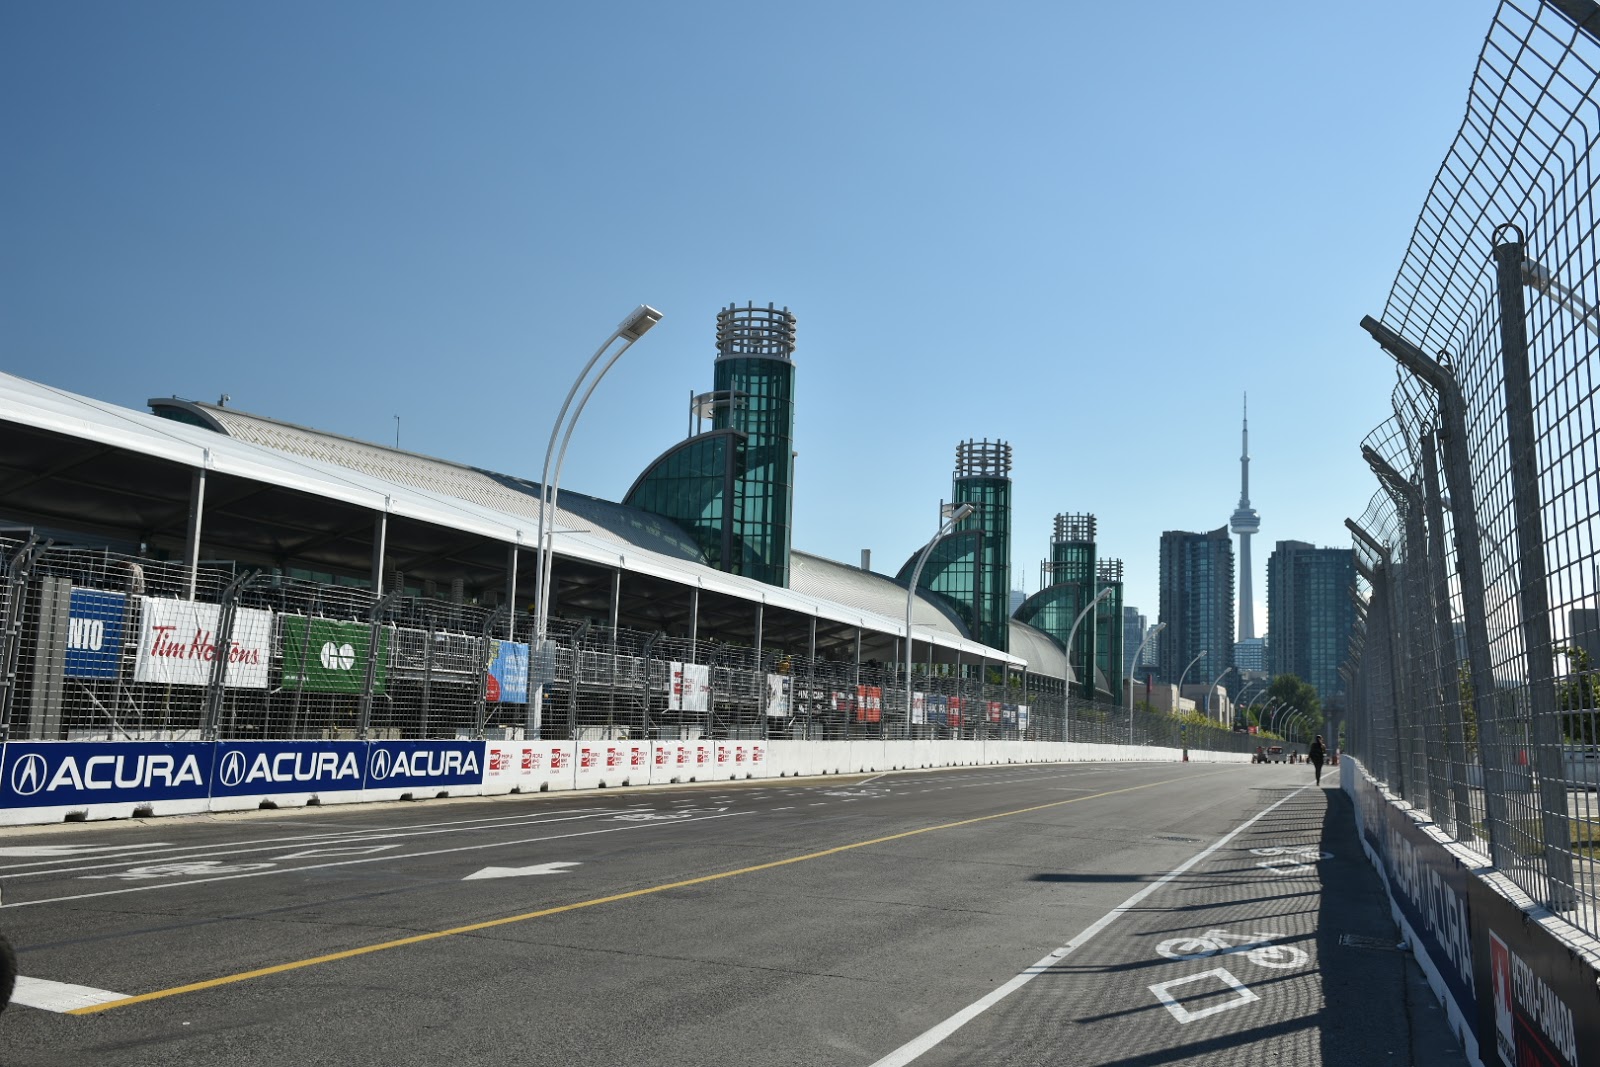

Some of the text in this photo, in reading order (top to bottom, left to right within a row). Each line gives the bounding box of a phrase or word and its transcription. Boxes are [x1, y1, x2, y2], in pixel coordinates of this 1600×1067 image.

[151, 626, 258, 664] Tim Hoons
[46, 754, 203, 791] ACURA
[245, 752, 360, 783] ACURA
[390, 750, 479, 777] ACURA
[1426, 863, 1477, 1001] ACURA
[1512, 950, 1578, 1067] PETRO-CANADA
